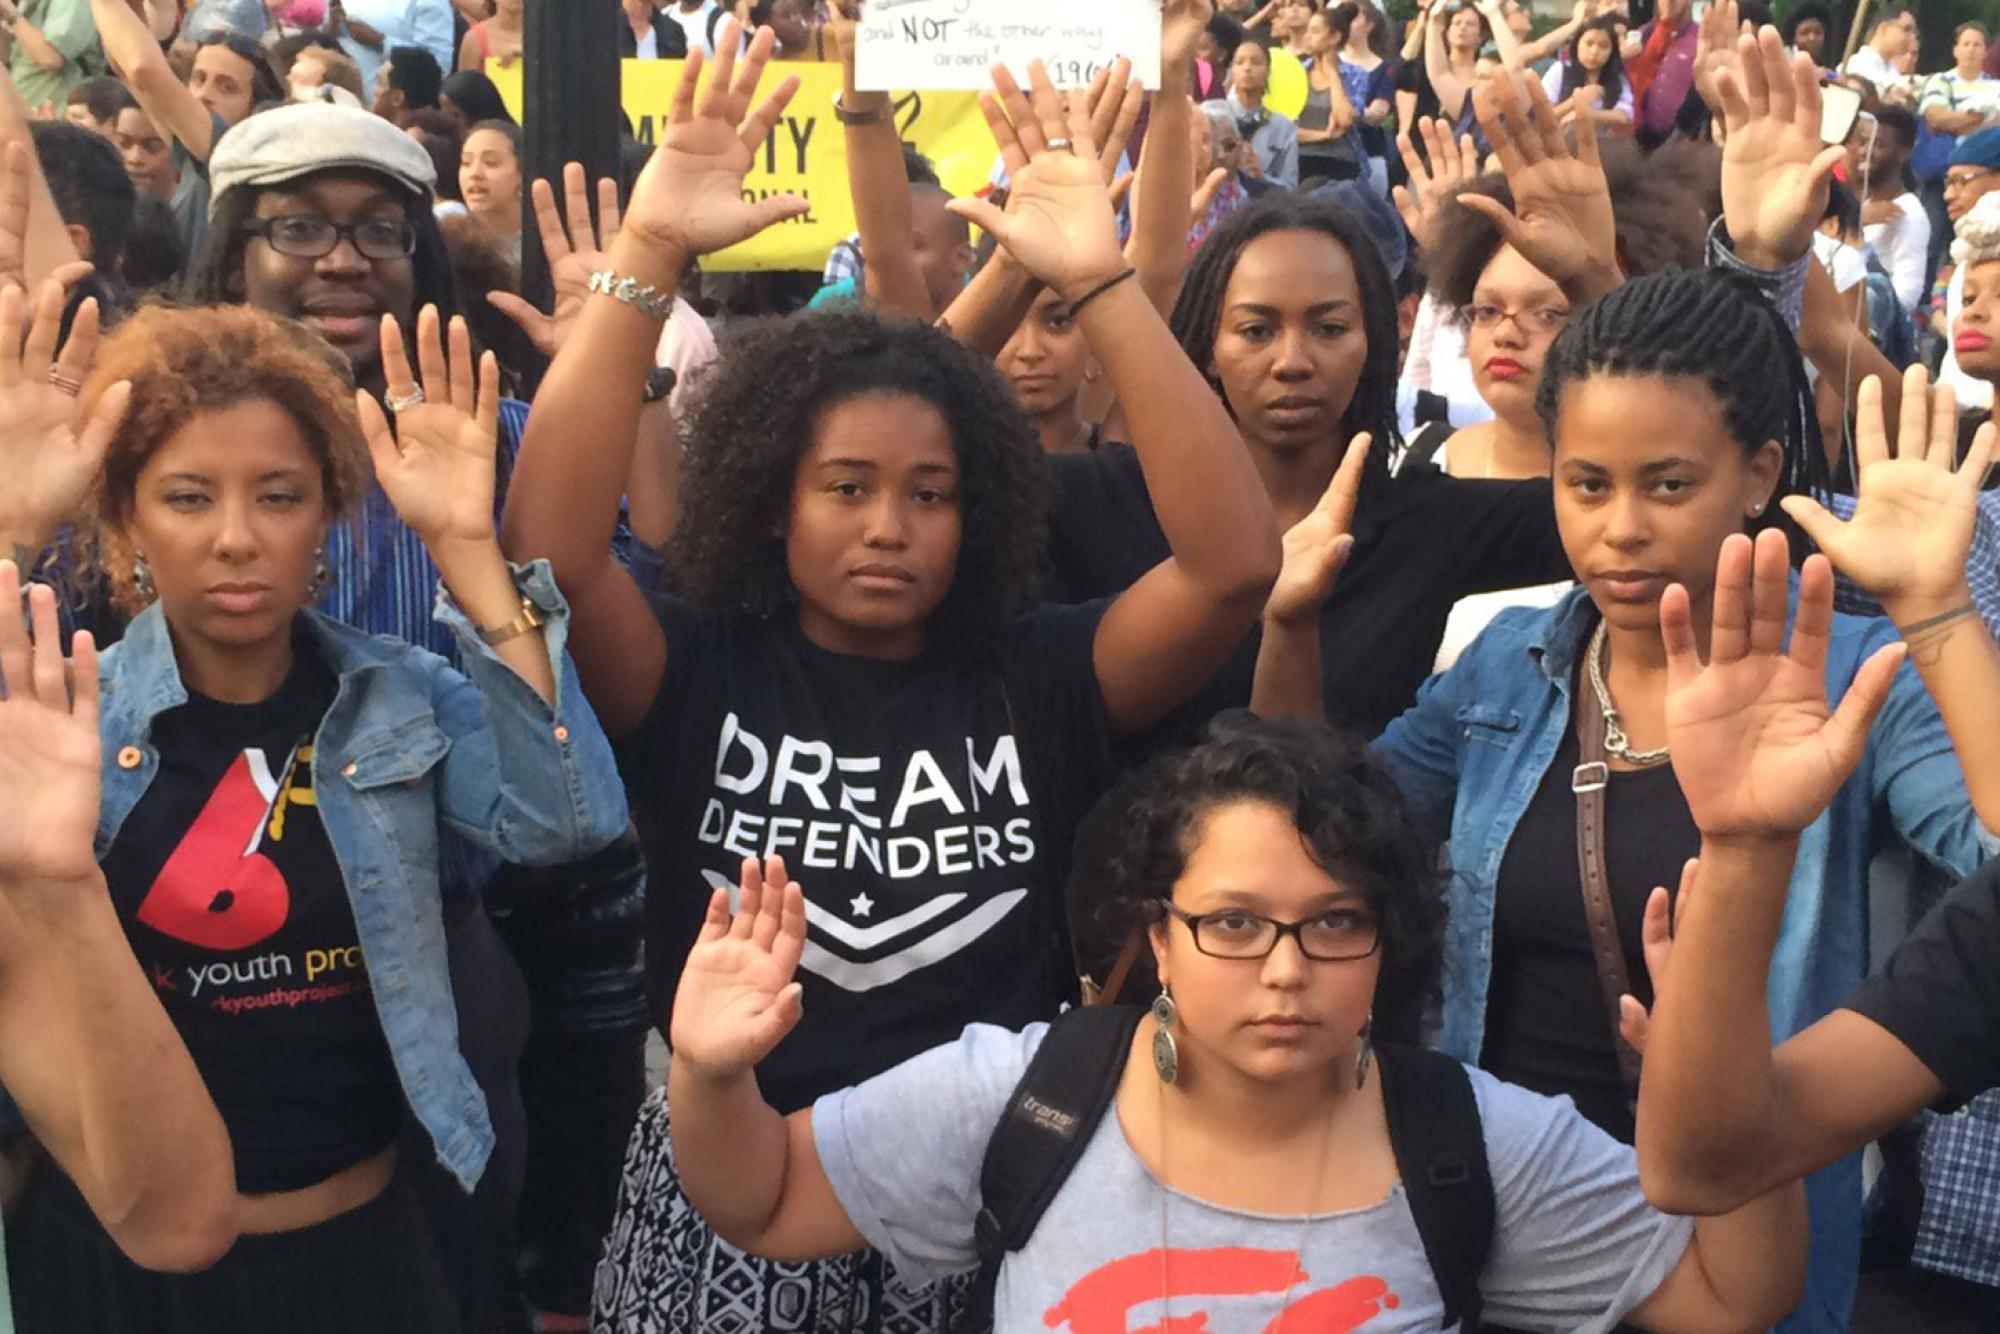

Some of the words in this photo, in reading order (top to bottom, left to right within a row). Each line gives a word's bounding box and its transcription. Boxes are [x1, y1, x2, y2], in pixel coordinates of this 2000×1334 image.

[864, 24, 894, 42] and
[901, 16, 958, 44] NOT
[963, 19, 996, 40] the
[714, 711, 1030, 830] DREAM
[698, 798, 1036, 880] DEFENDERS
[187, 952, 292, 997] youth
